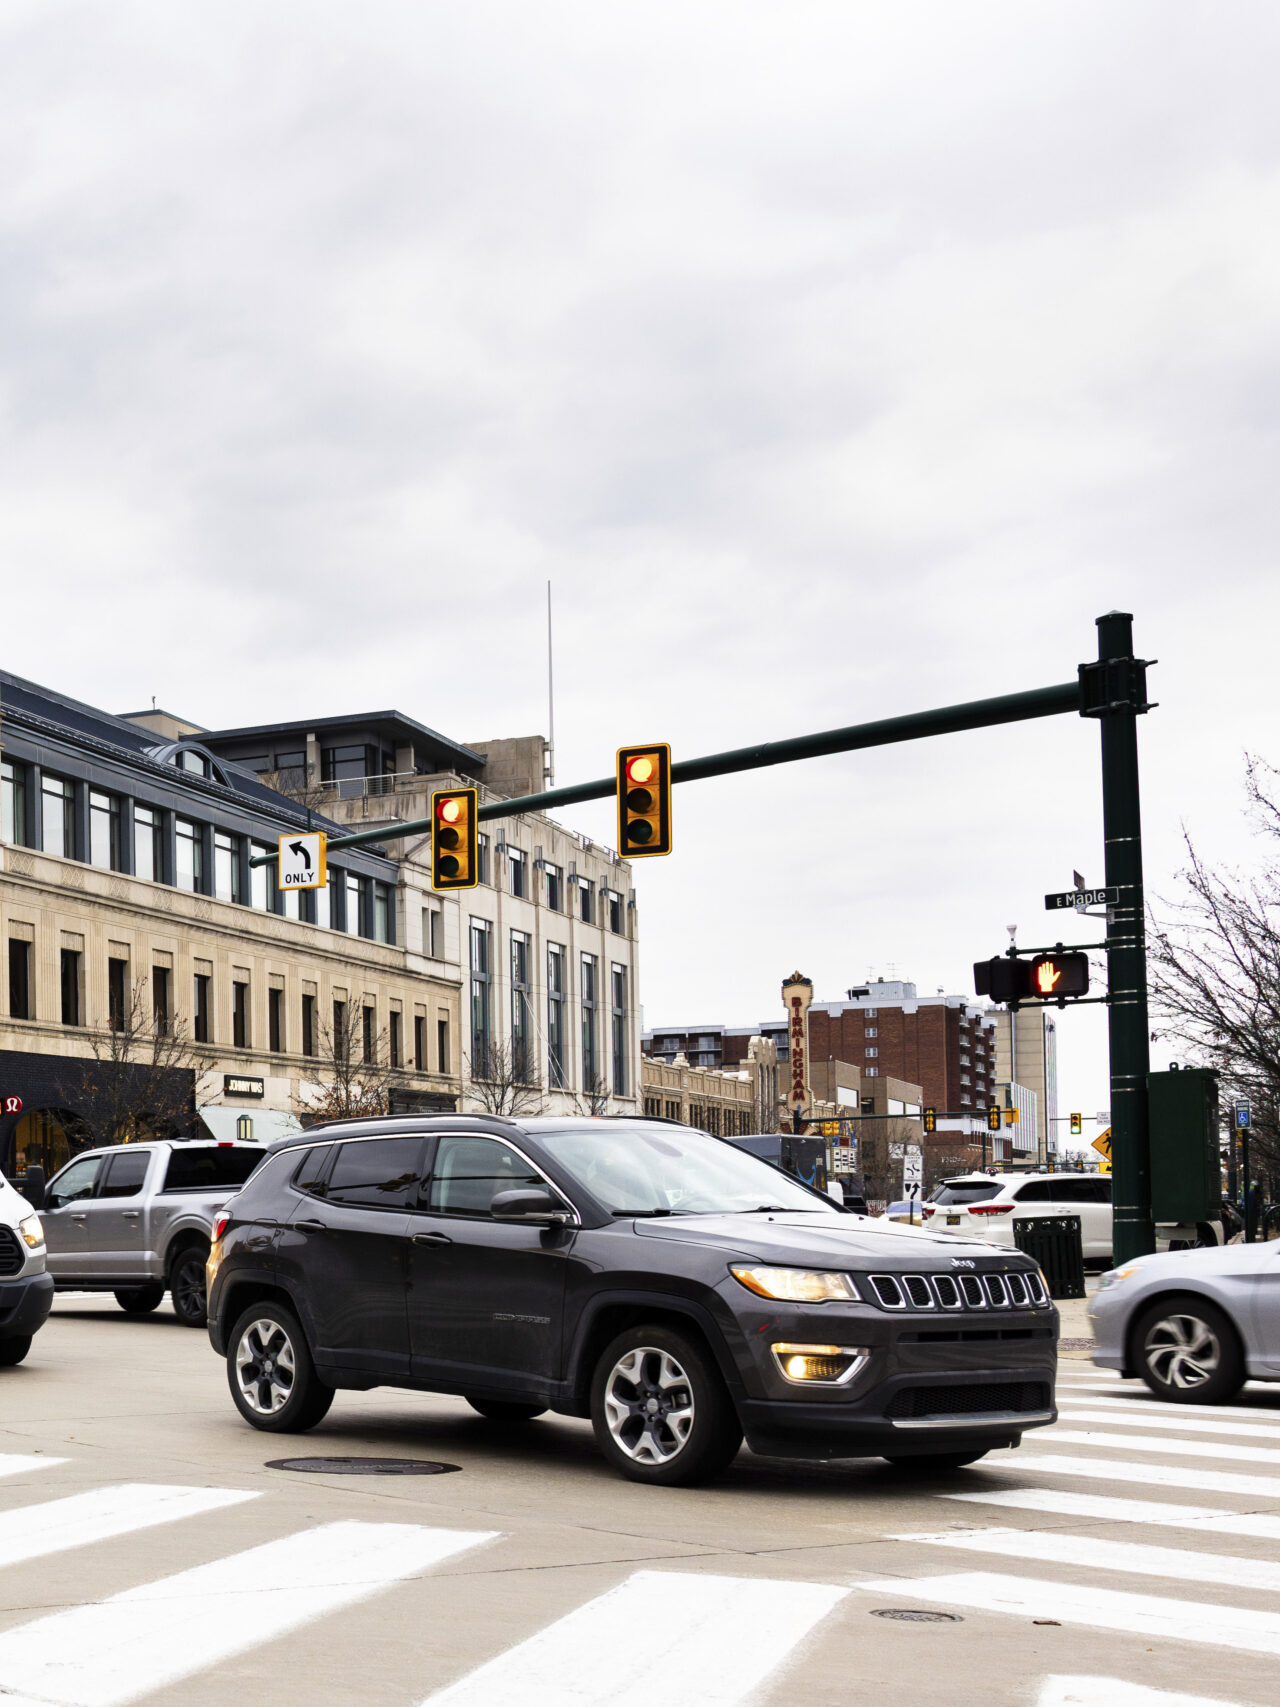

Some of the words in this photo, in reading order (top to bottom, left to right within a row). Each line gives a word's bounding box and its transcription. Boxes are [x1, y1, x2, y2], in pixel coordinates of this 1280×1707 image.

[285, 872, 314, 884] ONLY
[1056, 897, 1063, 907] E
[1065, 890, 1106, 906] Maple
[791, 997, 805, 1101] BIRMINGHAM
